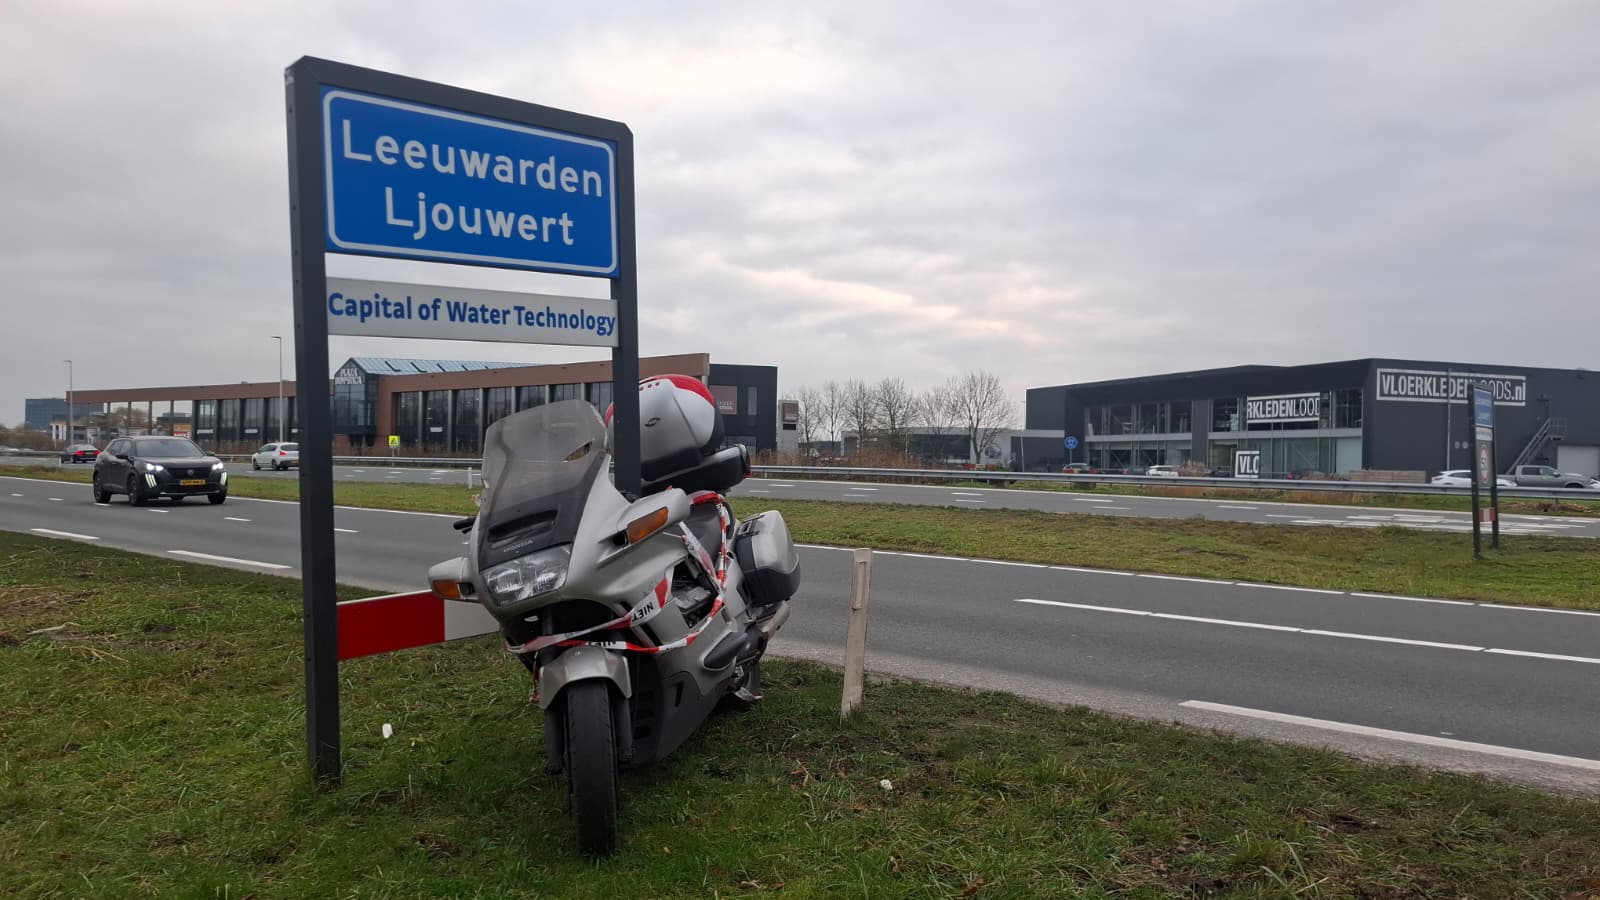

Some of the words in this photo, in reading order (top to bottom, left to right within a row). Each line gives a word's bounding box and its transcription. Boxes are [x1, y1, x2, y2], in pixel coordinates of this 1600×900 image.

[342, 119, 602, 197] Leeuwarden
[385, 186, 574, 245] Ljouwert
[328, 293, 412, 322] Capital
[418, 298, 441, 321] of
[446, 301, 510, 325] Water
[513, 305, 616, 336] Technology
[632, 602, 654, 621] NIET
